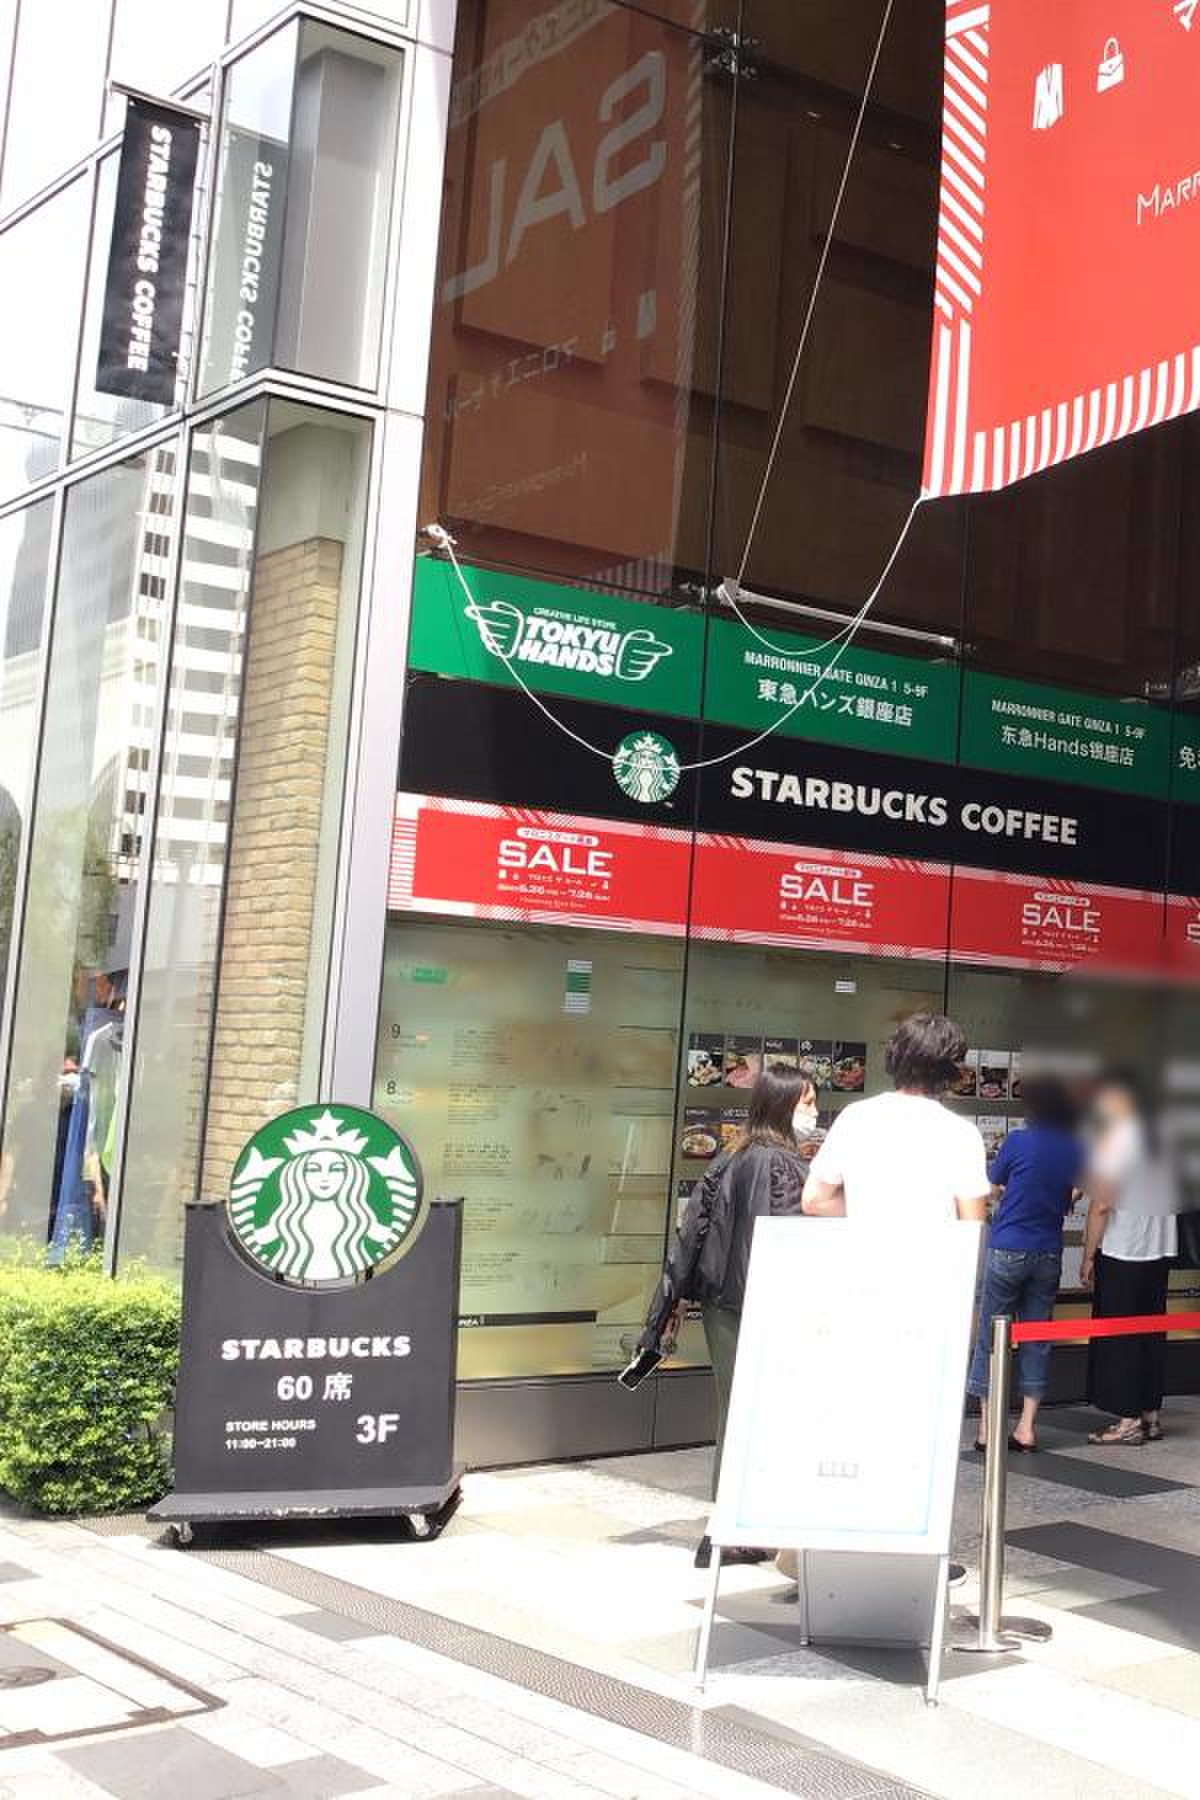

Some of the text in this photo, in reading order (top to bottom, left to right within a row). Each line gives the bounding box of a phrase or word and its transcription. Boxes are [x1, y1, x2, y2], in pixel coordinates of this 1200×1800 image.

[126, 123, 173, 373] STARBUCKS COFFEE
[526, 616, 622, 655] TOKYU
[518, 640, 617, 676] HANDS
[744, 650, 821, 677] MARRONNIER
[757, 678, 913, 728] 東急ハンズ銀座店
[731, 766, 1079, 846] STARBUCKS COFFEE
[497, 839, 614, 878] SALE
[779, 873, 875, 907] SALE
[1022, 903, 1101, 933] SALE
[221, 1336, 411, 1360] STARBUCKS
[277, 1372, 353, 1401] 60 席
[225, 1419, 317, 1432] STORE HOURS
[356, 1413, 400, 1443] 3F
